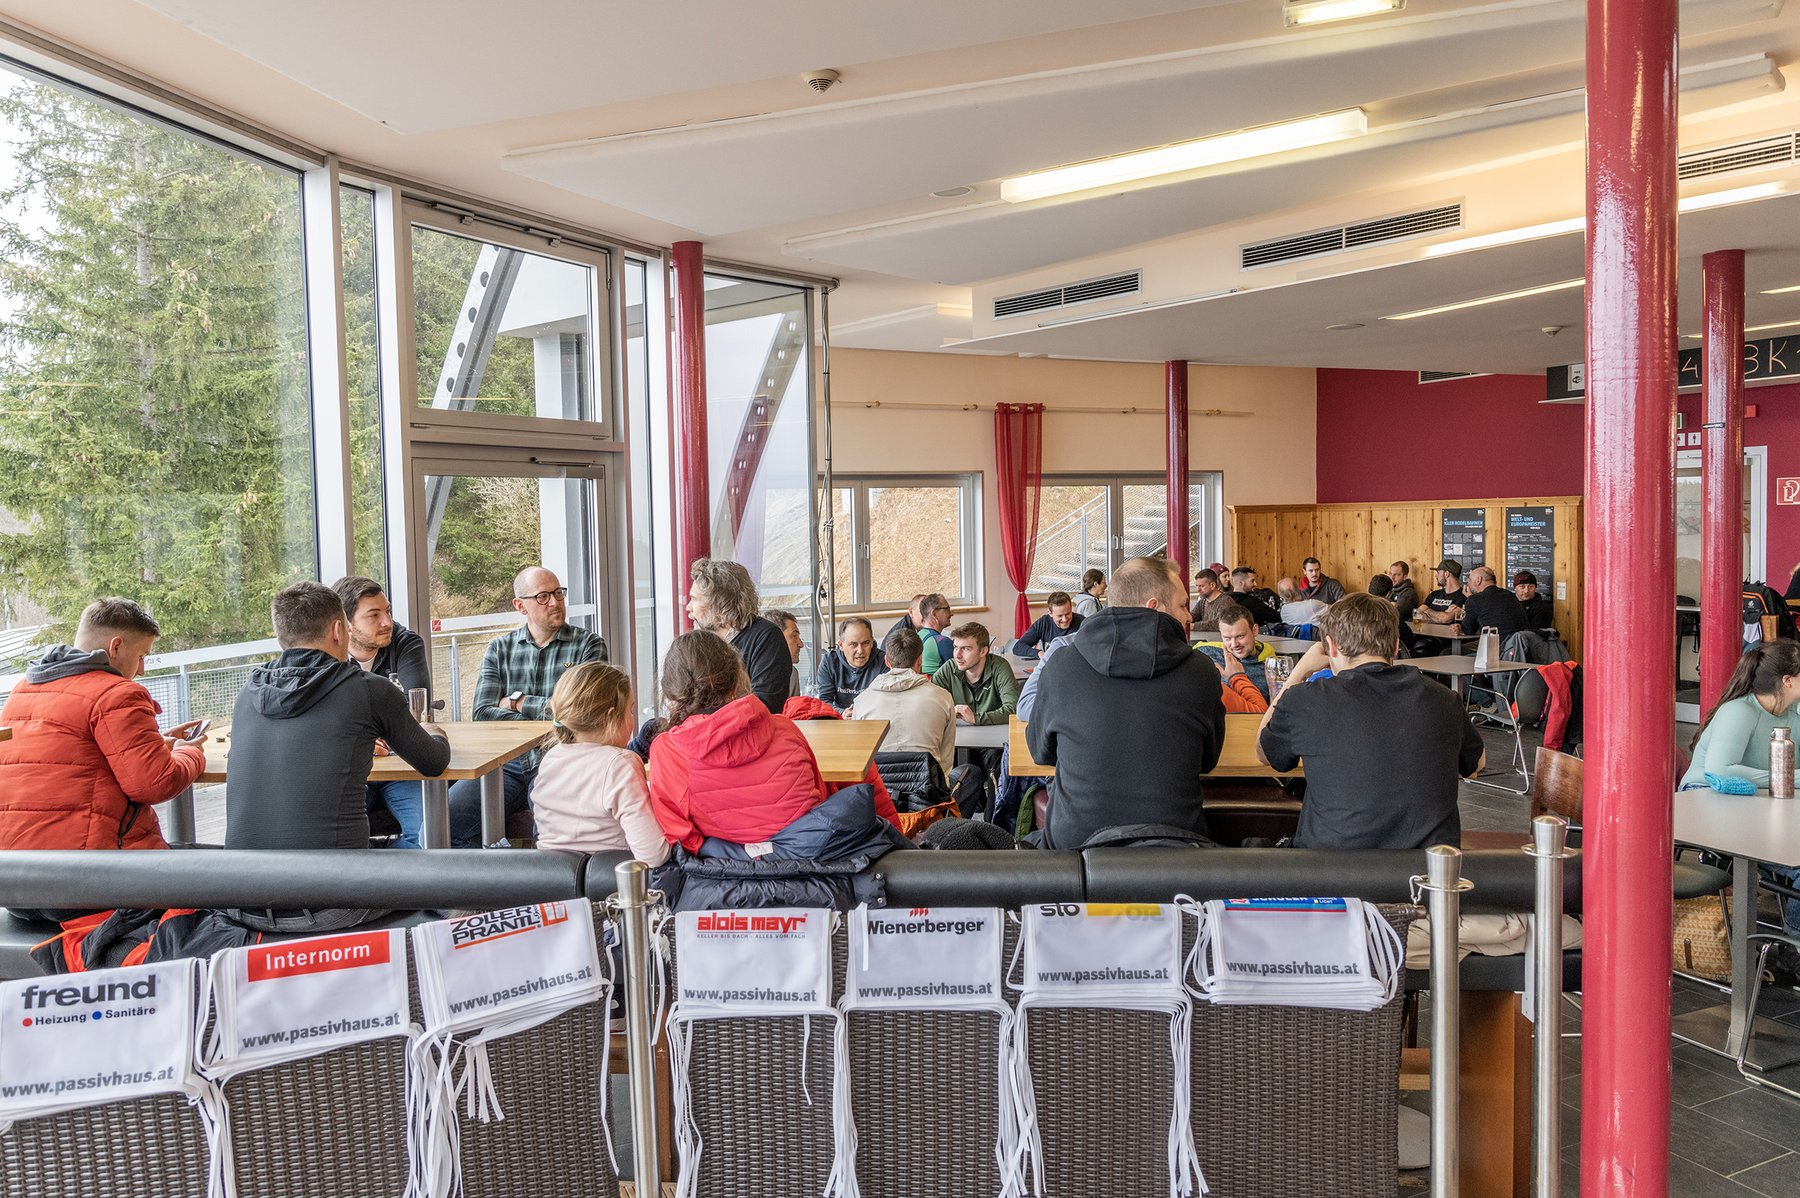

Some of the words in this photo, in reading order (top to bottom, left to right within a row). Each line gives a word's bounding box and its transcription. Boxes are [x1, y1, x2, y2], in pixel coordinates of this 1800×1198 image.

[450, 906, 532, 933] ZOLLER
[1040, 902, 1080, 917] sto
[452, 915, 541, 945] PRANTL
[697, 912, 749, 931] alois
[751, 917, 806, 934] mayr
[868, 919, 985, 935] Wienerberger
[265, 943, 371, 971] Internorm
[1038, 966, 1169, 984] www.passivhaus.at
[1226, 961, 1360, 976] www.passivhaus.at
[21, 974, 157, 1010] freund
[450, 965, 593, 1014] www.passivhaus.at
[684, 987, 817, 1003] www.passivhaus.at
[858, 982, 993, 1000] www.passivhaus.at
[35, 1013, 87, 1026] Heizung
[105, 1006, 157, 1019] Sanitäre
[242, 1012, 401, 1049] www.passivhaus.at
[2, 1066, 175, 1098] www.passivhaus.at
